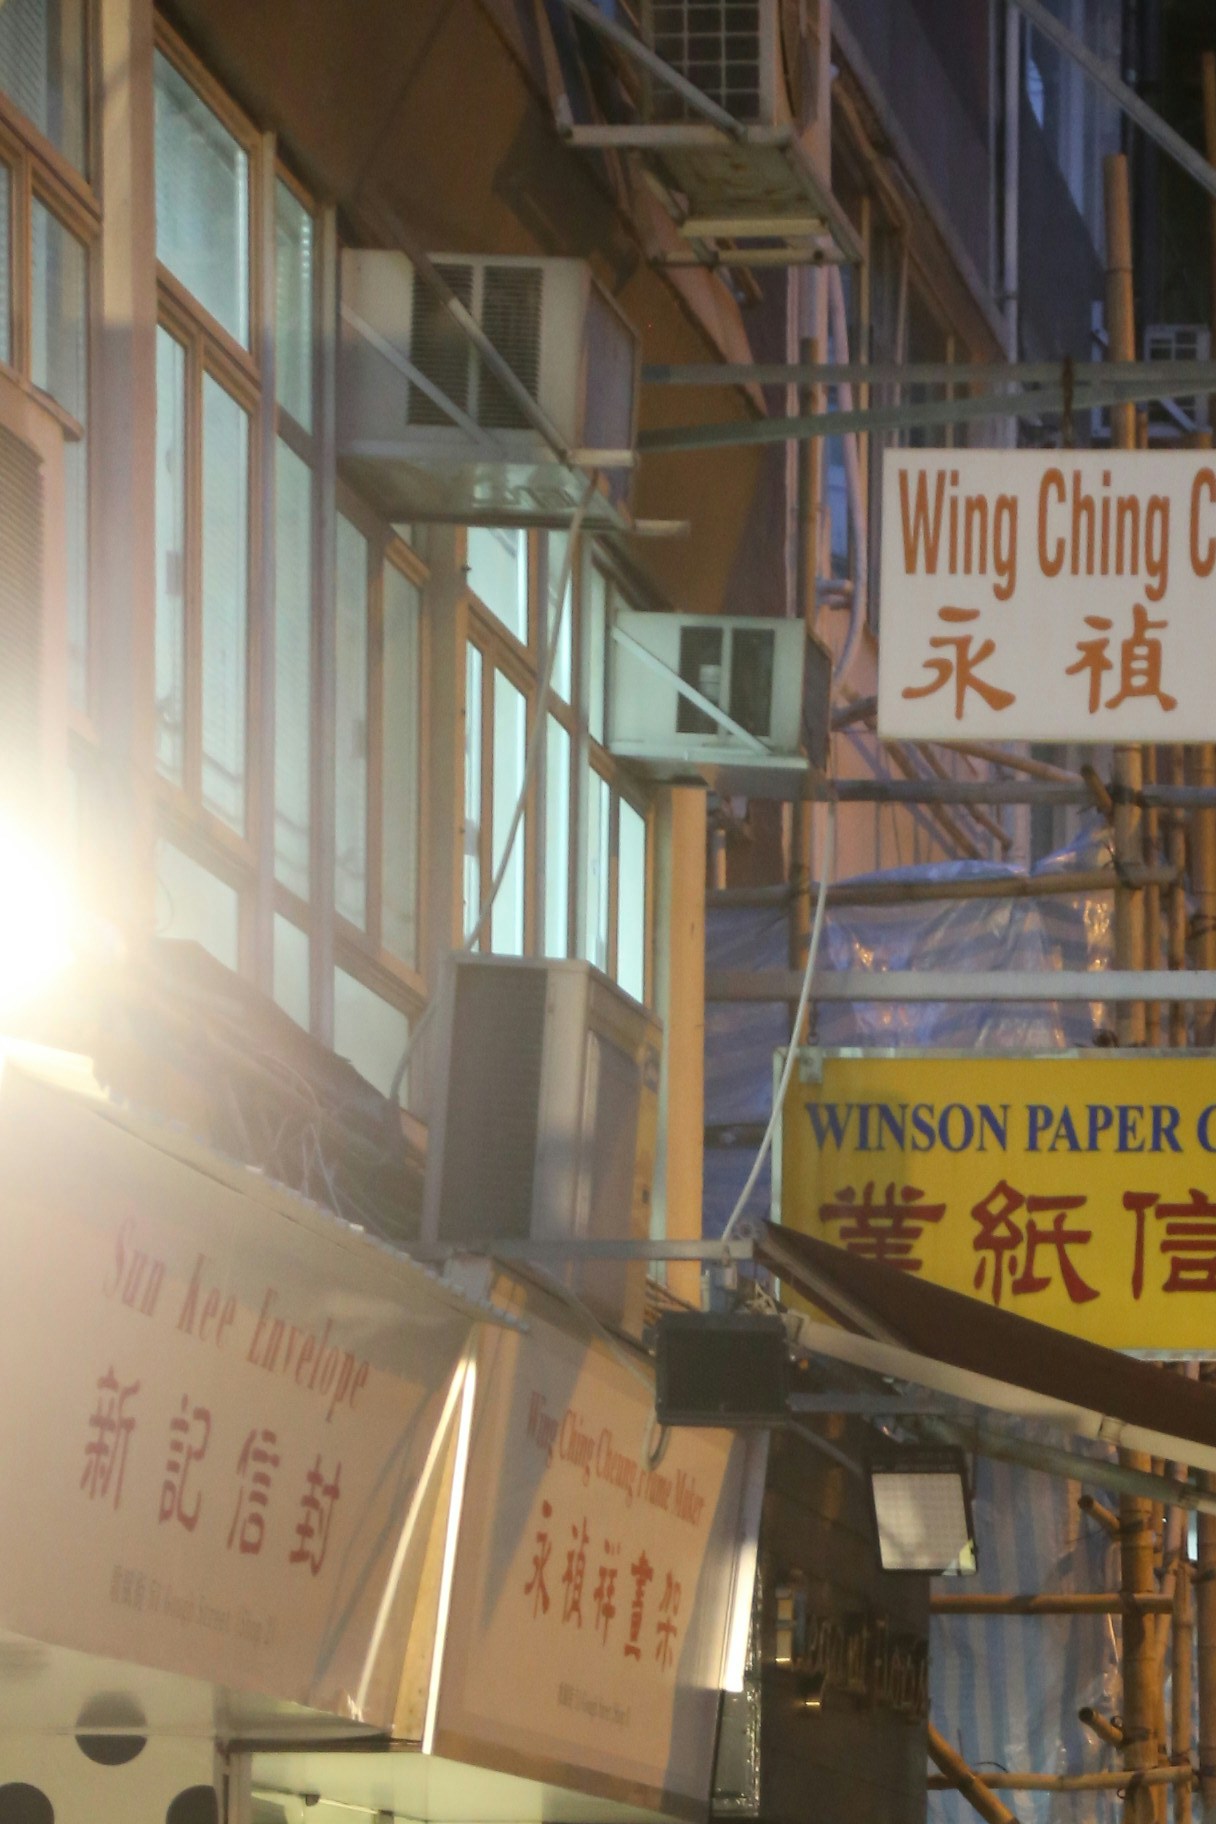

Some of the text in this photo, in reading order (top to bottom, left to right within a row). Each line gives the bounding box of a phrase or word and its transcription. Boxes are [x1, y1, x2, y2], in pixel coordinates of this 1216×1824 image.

[898, 468, 1018, 601] Wing
[1037, 466, 1170, 601] Ching
[805, 1102, 1011, 1153] WINSON
[1025, 1104, 1184, 1154] PAPER
[102, 1214, 370, 1424] Sun Kee Envelope
[80, 1363, 342, 1577] 新記信封
[527, 1390, 560, 1469] Wing
[559, 1408, 596, 1488] Ching
[596, 1427, 638, 1508] Cheung
[674, 1468, 706, 1528] Maker
